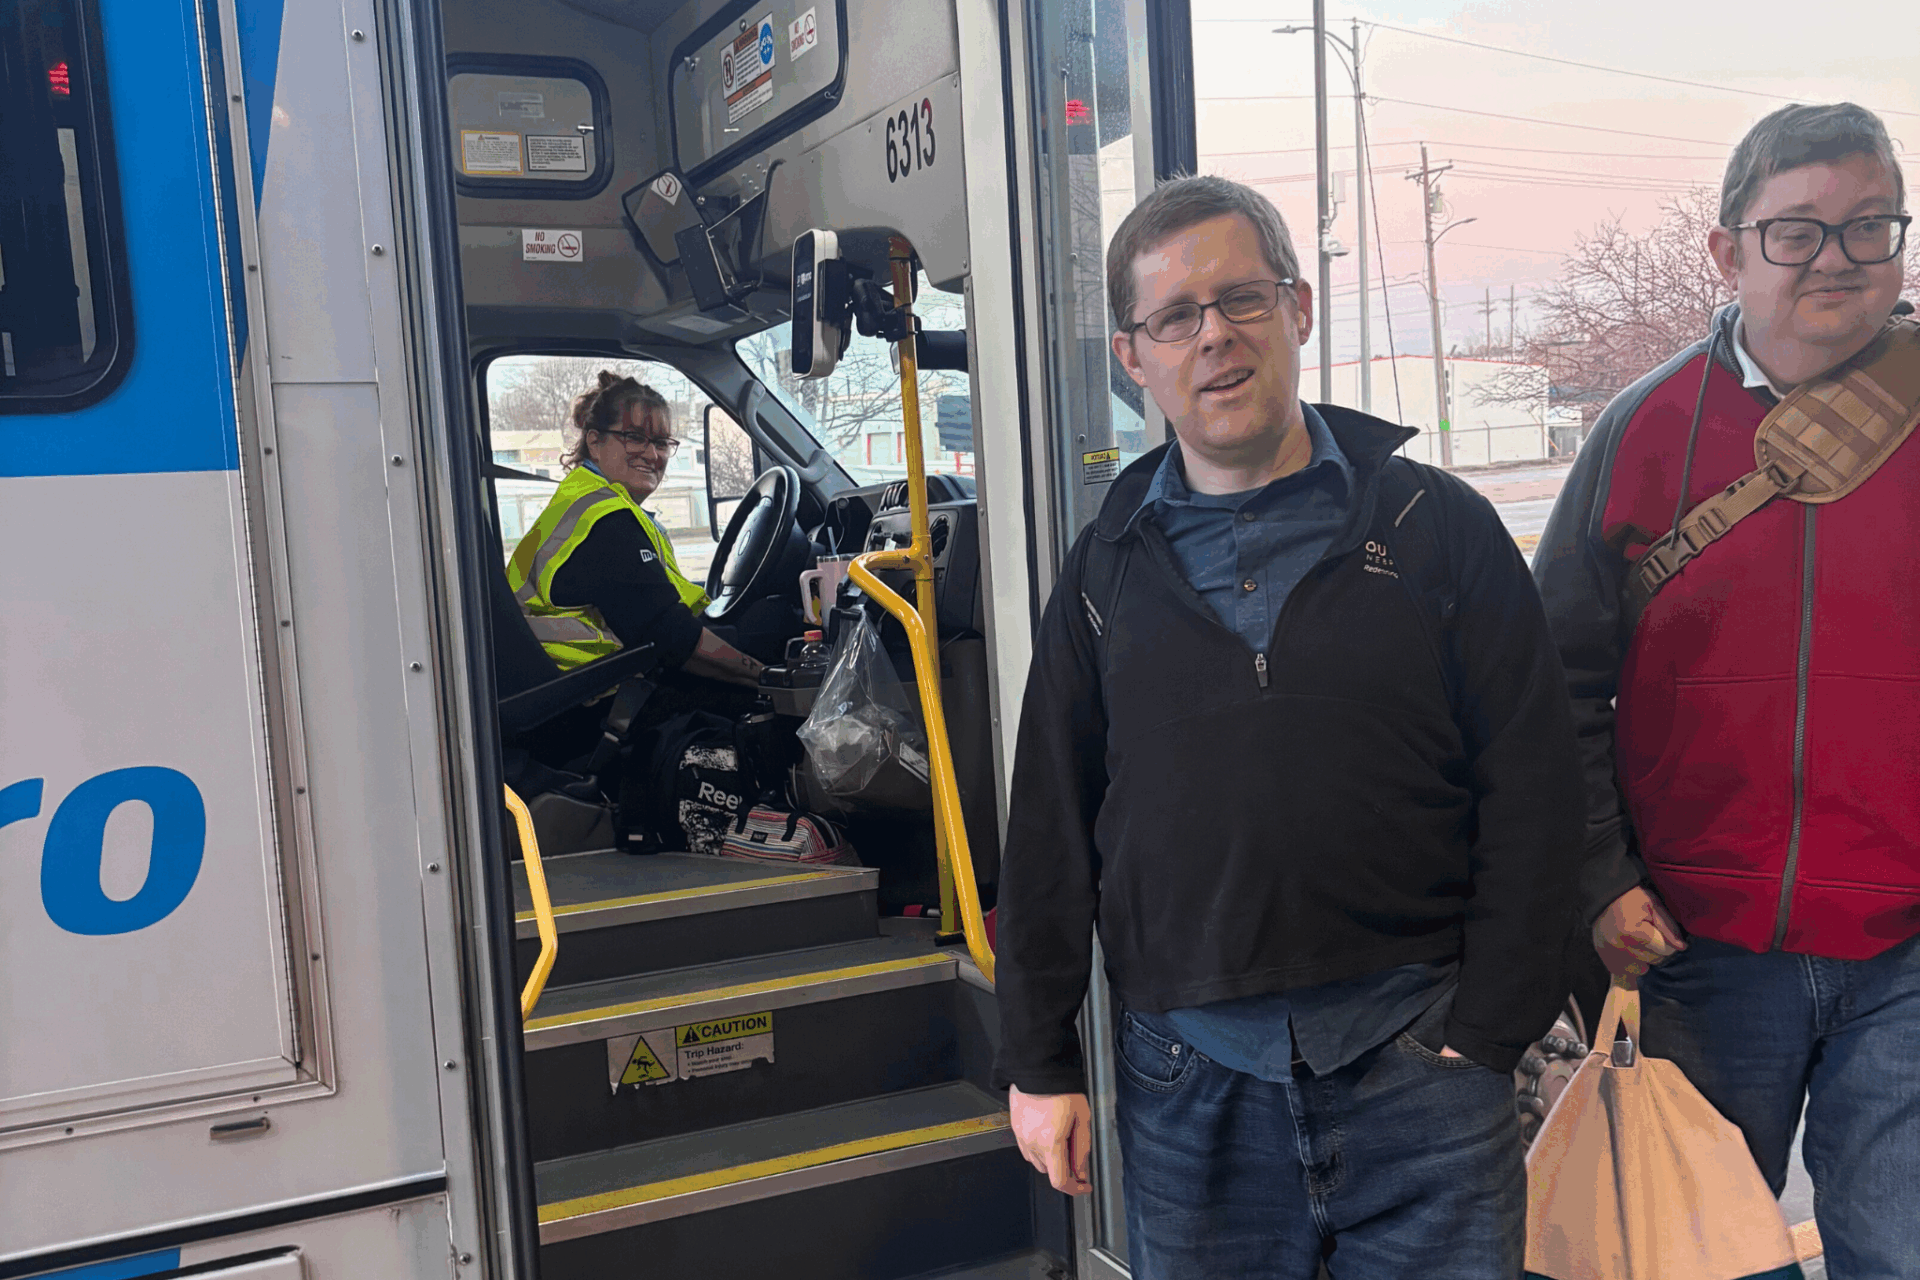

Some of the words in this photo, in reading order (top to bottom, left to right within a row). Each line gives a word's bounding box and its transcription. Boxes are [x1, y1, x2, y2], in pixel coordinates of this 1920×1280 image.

[886, 97, 936, 183] 6313
[534, 231, 545, 242] NO
[525, 243, 556, 254] SMOKING
[697, 781, 743, 810] Ree
[701, 1016, 767, 1039] CAUTION
[684, 1050, 704, 1059] Trip
[707, 1042, 745, 1056] Hazard:
